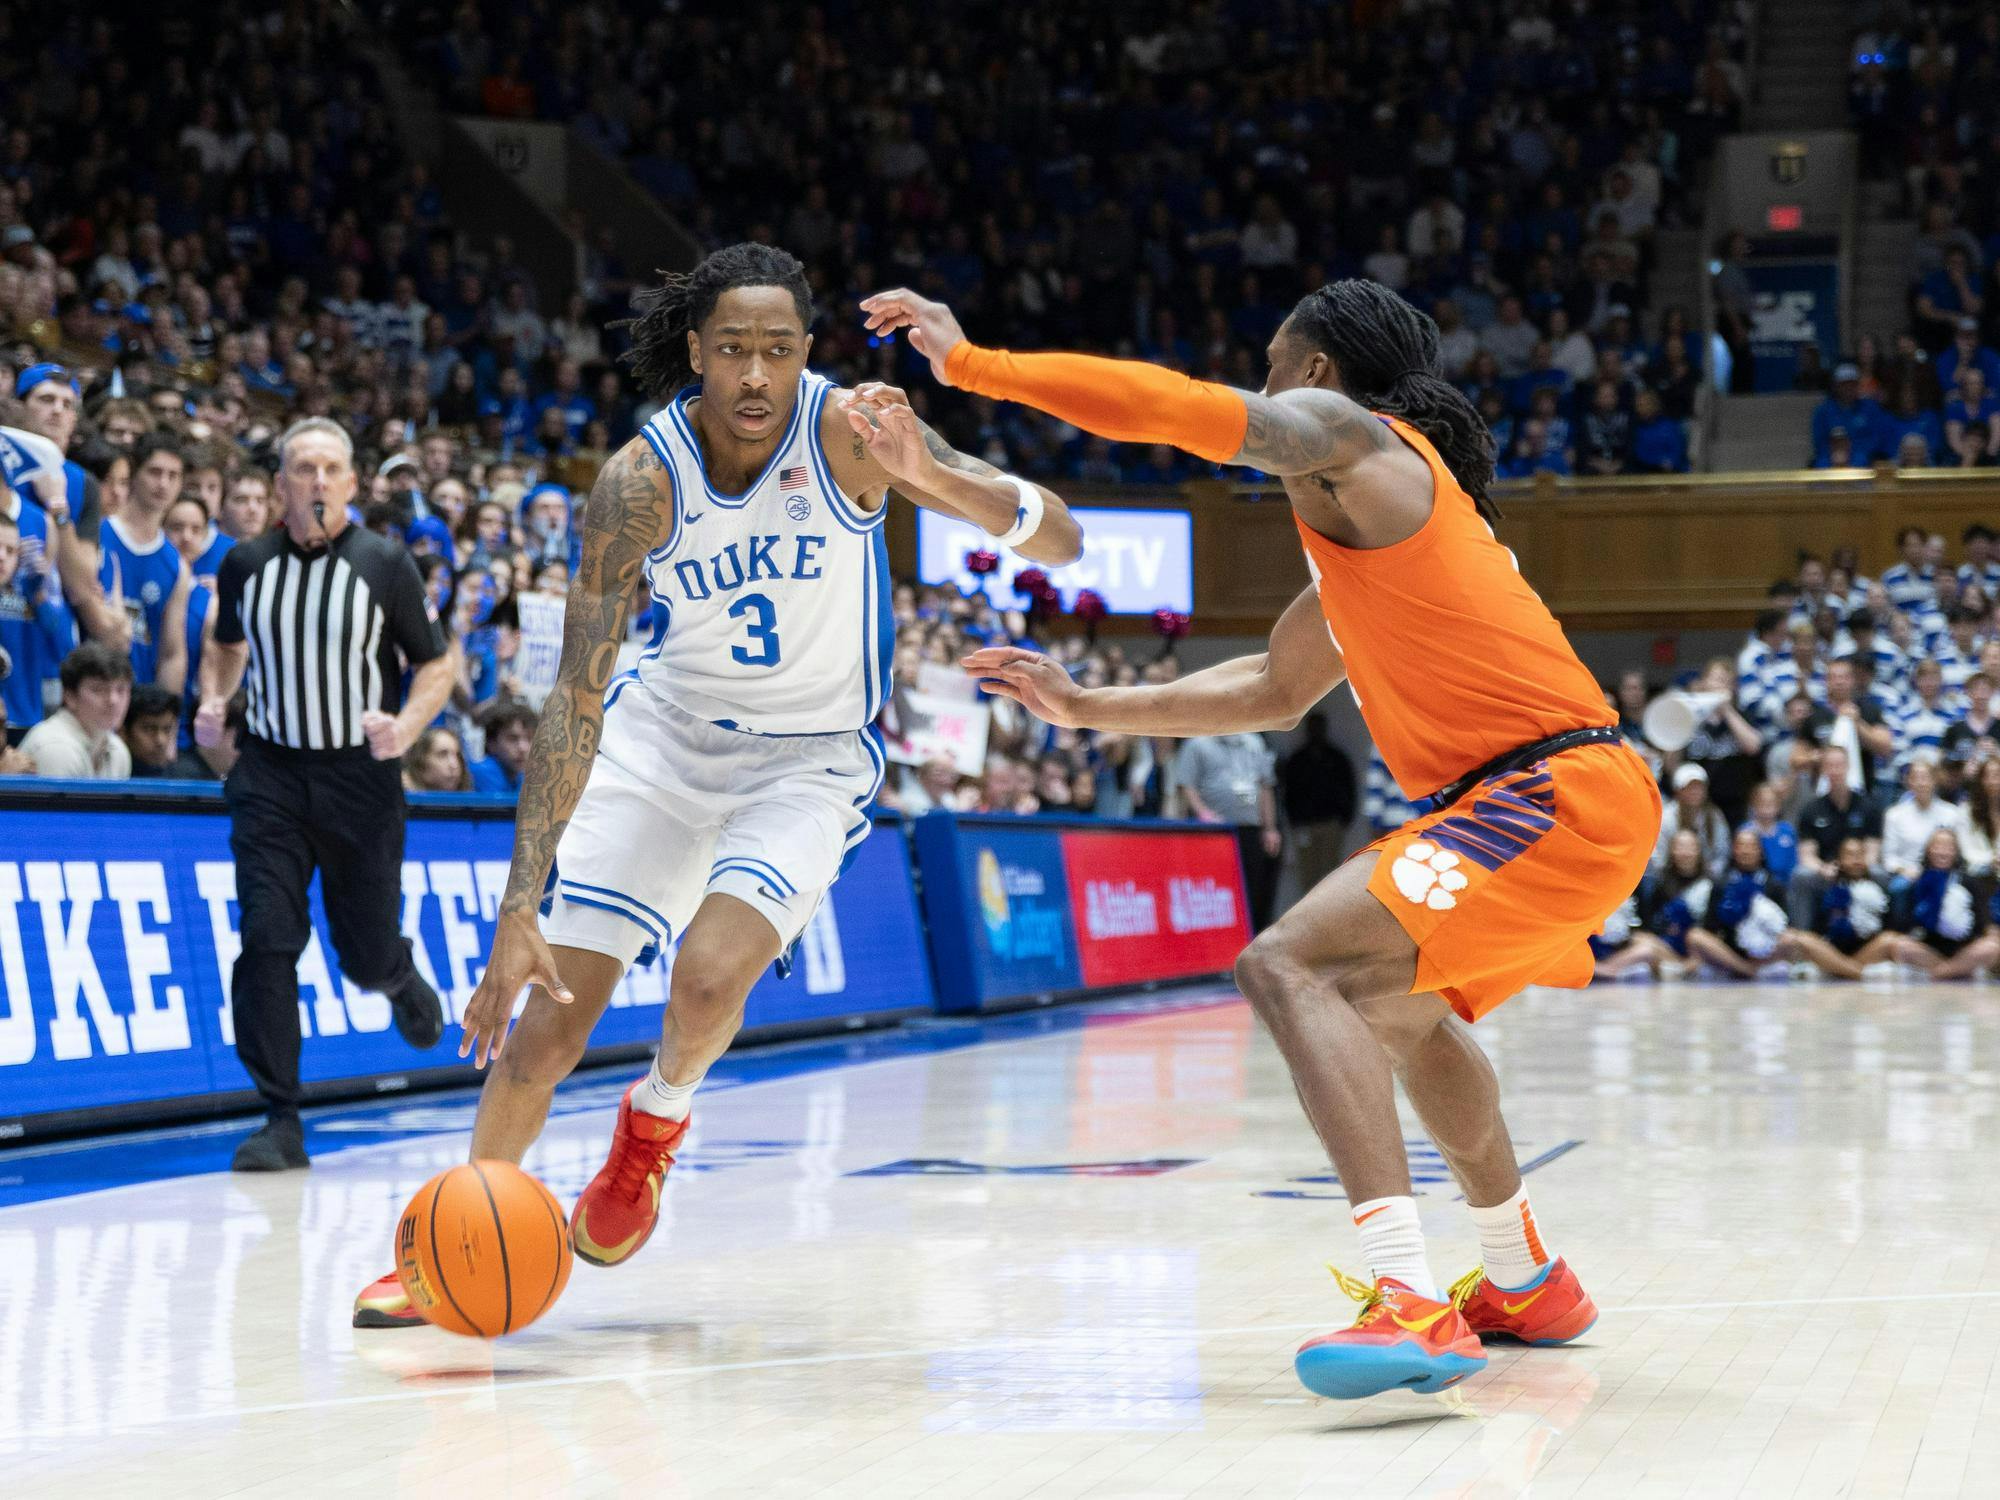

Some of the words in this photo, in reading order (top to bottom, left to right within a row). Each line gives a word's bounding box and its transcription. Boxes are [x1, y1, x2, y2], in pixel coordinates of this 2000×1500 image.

[789, 502, 809, 511] ACC
[674, 534, 827, 601] DUKE
[727, 593, 781, 668] 3
